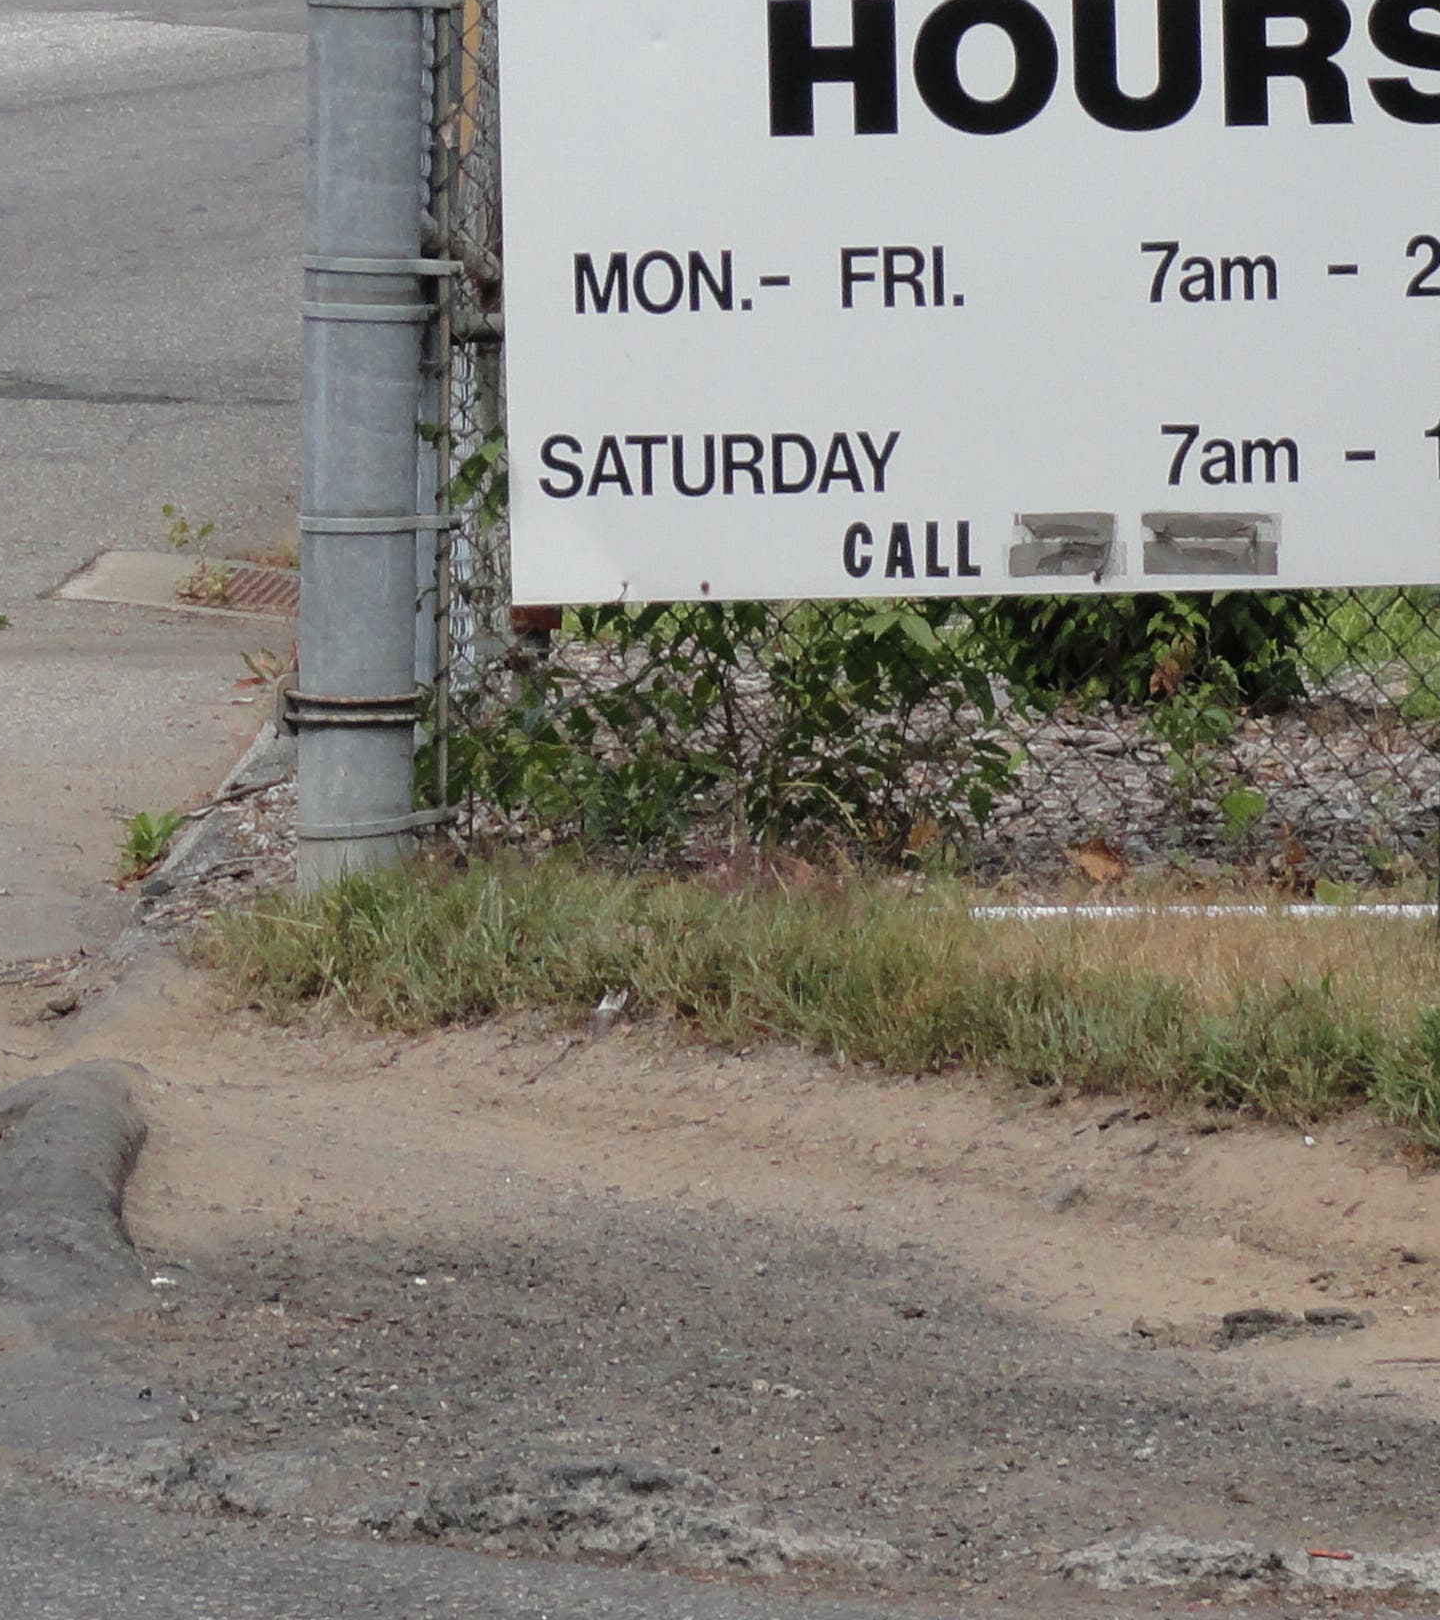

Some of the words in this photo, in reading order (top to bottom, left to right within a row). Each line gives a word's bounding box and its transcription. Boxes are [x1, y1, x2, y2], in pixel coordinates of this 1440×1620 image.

[840, 246, 964, 308] FRI.
[1141, 240, 1278, 303] 7am
[539, 430, 900, 499] SATURDAY
[1161, 423, 1299, 486] 7am
[842, 519, 981, 579] CALL
